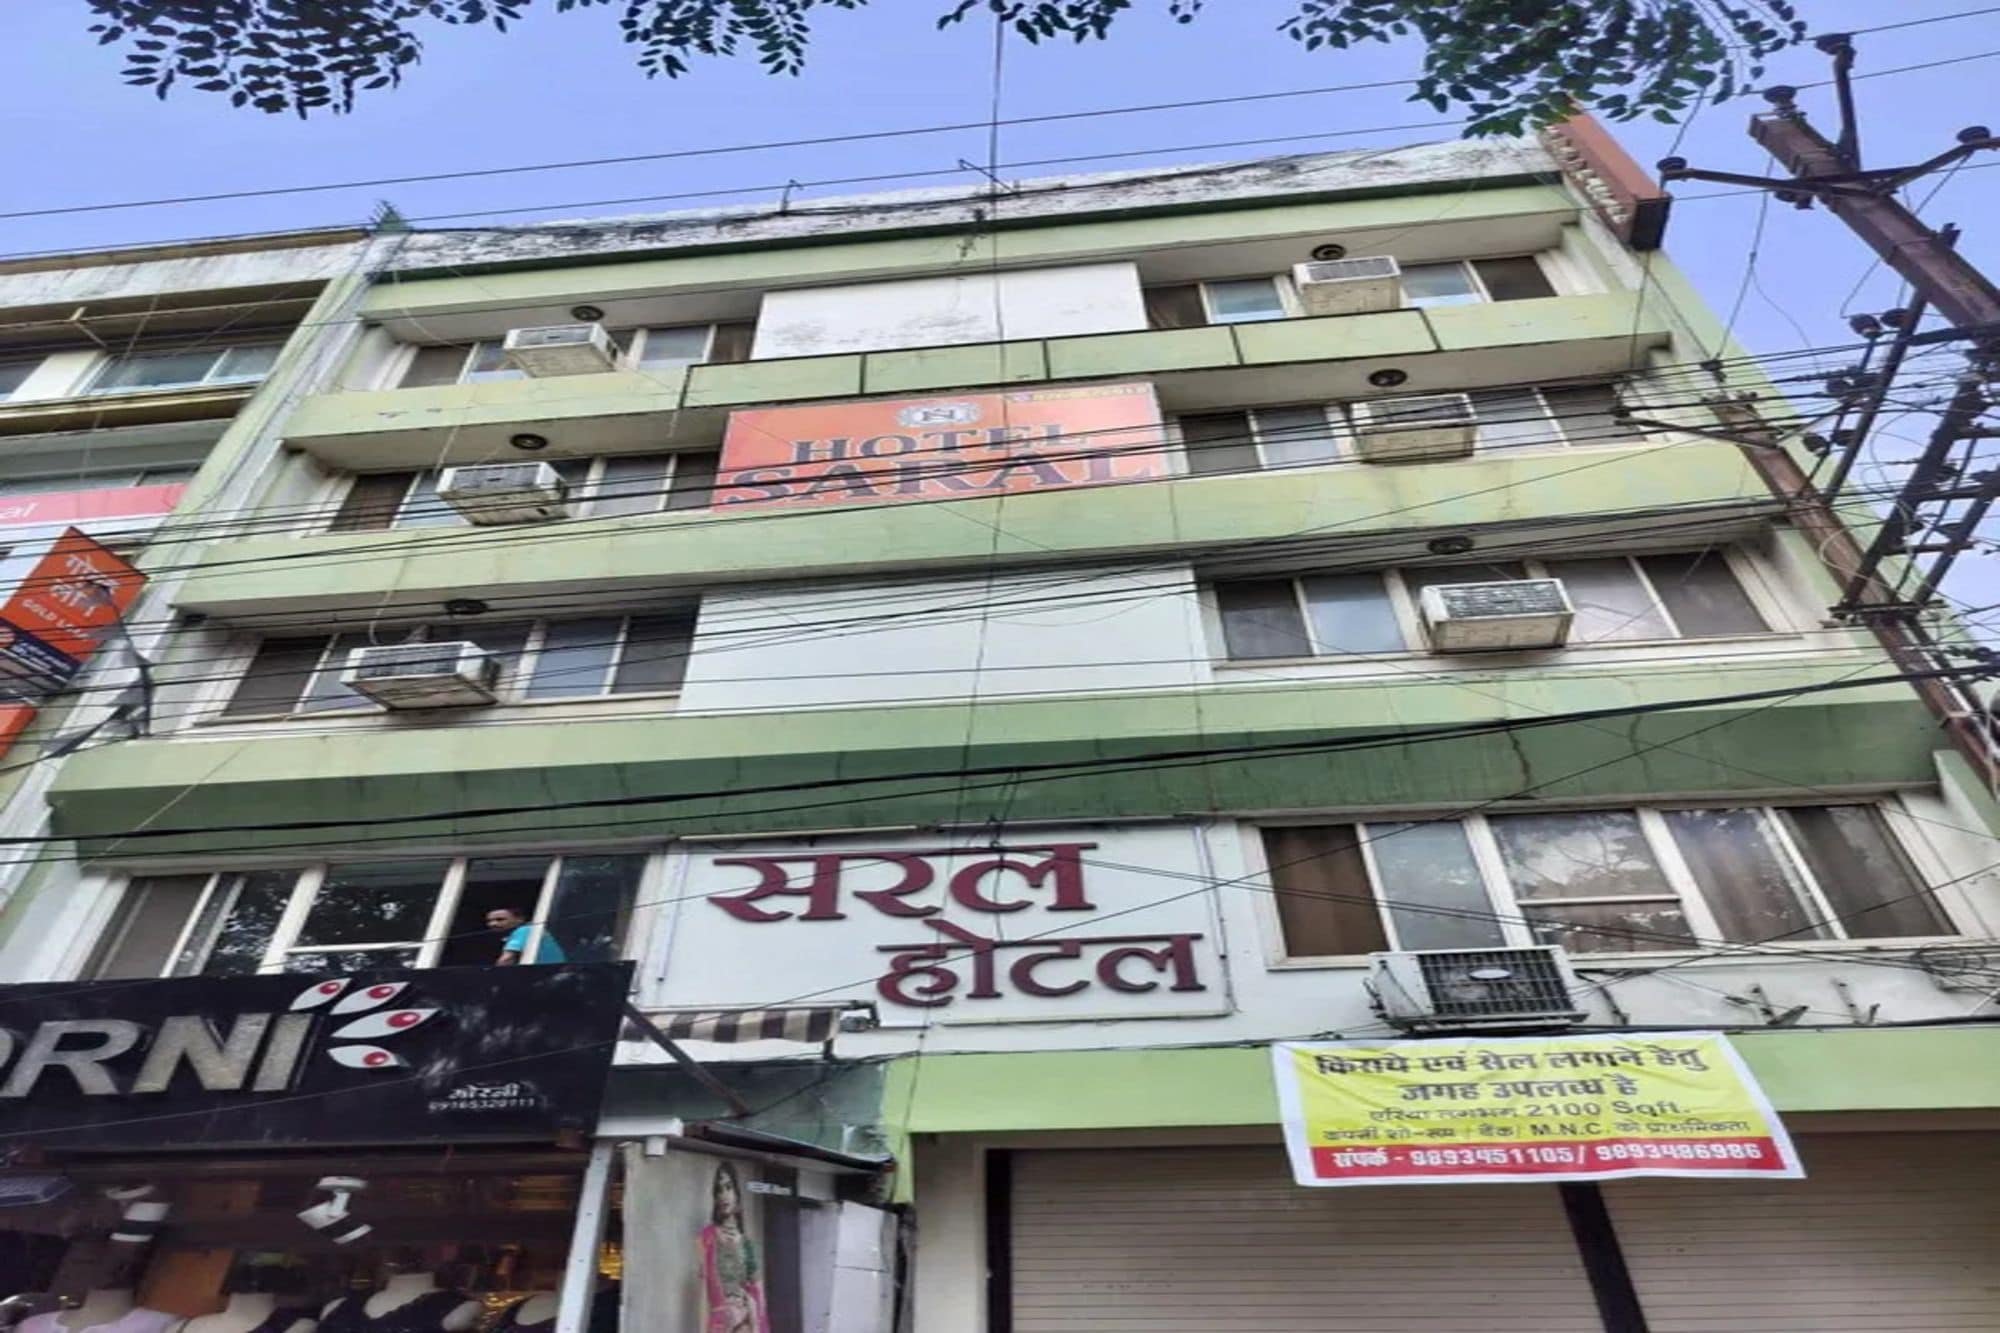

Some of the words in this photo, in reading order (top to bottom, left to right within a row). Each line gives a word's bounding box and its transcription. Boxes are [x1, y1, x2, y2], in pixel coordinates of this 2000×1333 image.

[793, 423, 1088, 464] HOTEL
[724, 450, 1152, 505] SARAL
[708, 842, 1098, 922] सरल
[876, 919, 1206, 1007] होटल
[1315, 1053, 1408, 1074] किराये
[1421, 1051, 1467, 1072] एवं
[1479, 1050, 1538, 1070] सेल
[1544, 1046, 1645, 1067] लगाने
[1646, 1044, 1709, 1071] हेतु
[1397, 1082, 1480, 1101] जगह
[1487, 1077, 1605, 1098] उपलब्ध
[1602, 1073, 1637, 1096] है
[1526, 1101, 1601, 1117] 2100
[1612, 1100, 1691, 1117] Sqft.
[1333, 1146, 1388, 1168] संपर्क
